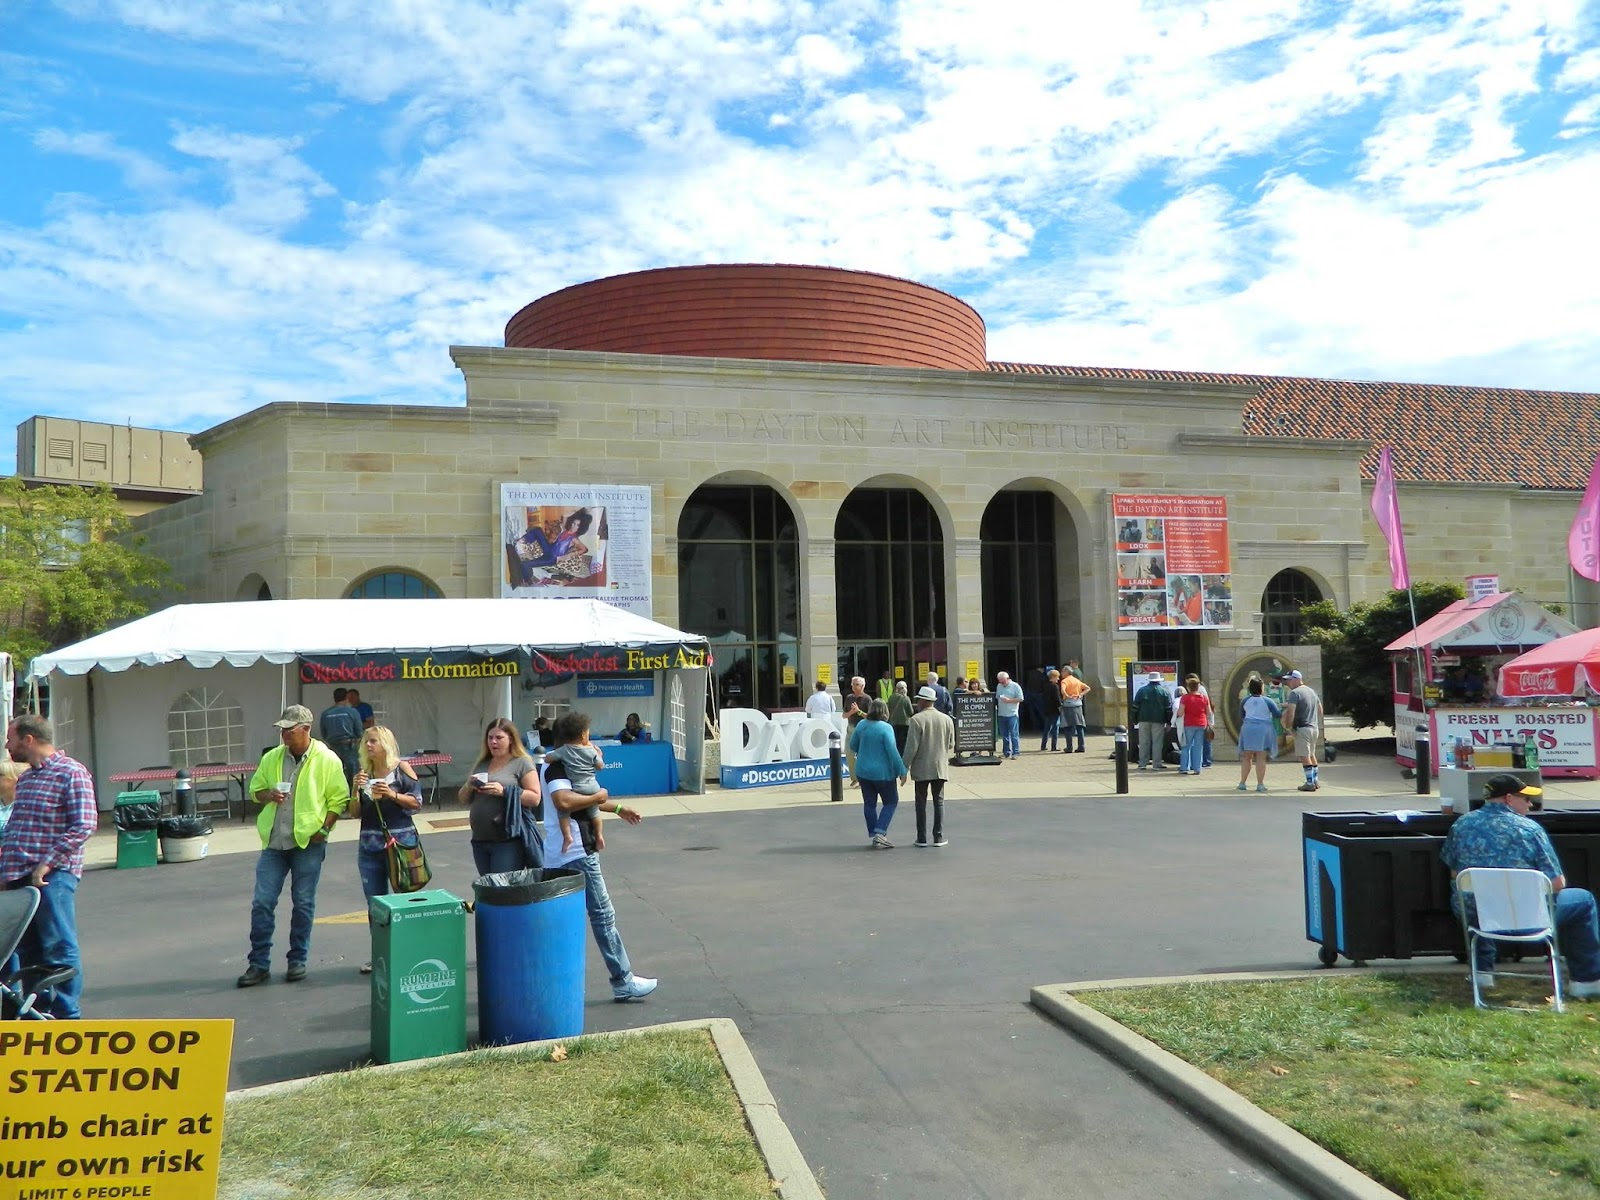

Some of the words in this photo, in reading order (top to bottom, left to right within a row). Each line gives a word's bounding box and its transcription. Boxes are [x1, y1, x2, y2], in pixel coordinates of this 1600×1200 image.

[628, 407, 702, 438] THE
[720, 412, 866, 443] DAYTON
[889, 418, 952, 445] ART
[967, 420, 1129, 451] INSTITUTE
[507, 491, 527, 499] THE
[530, 491, 570, 500] DAYTON
[573, 492, 592, 500] ART
[594, 492, 645, 501] INSTITUTE
[1135, 505, 1167, 513] DAYTON
[1184, 506, 1223, 514] INSTITUTE
[300, 660, 397, 684] Oktoberfest
[401, 657, 519, 679] Information
[532, 651, 620, 676] Oktoberfest
[625, 649, 671, 671] First
[673, 647, 706, 669] Aid
[1519, 668, 1556, 692] Coca-Cola
[1447, 714, 1499, 724] FRESH
[1515, 713, 1587, 725] ROASTED
[604, 761, 623, 769] ealth
[423, 909, 452, 917] RECYCLING
[400, 968, 457, 986] RUMPKE
[403, 980, 453, 992] RECYCLING
[0, 1030, 137, 1056] PHOTO
[148, 1030, 201, 1054] OP
[8, 1066, 181, 1094] STATION
[1, 1115, 69, 1141] imb
[80, 1112, 169, 1138] chair
[177, 1112, 213, 1135] at
[0, 1158, 47, 1179] ur
[57, 1157, 130, 1177] own
[141, 1148, 205, 1174] risk
[19, 1188, 68, 1200] LIMIT
[72, 1188, 82, 1199] 6
[87, 1185, 152, 1199] PEOPLE
